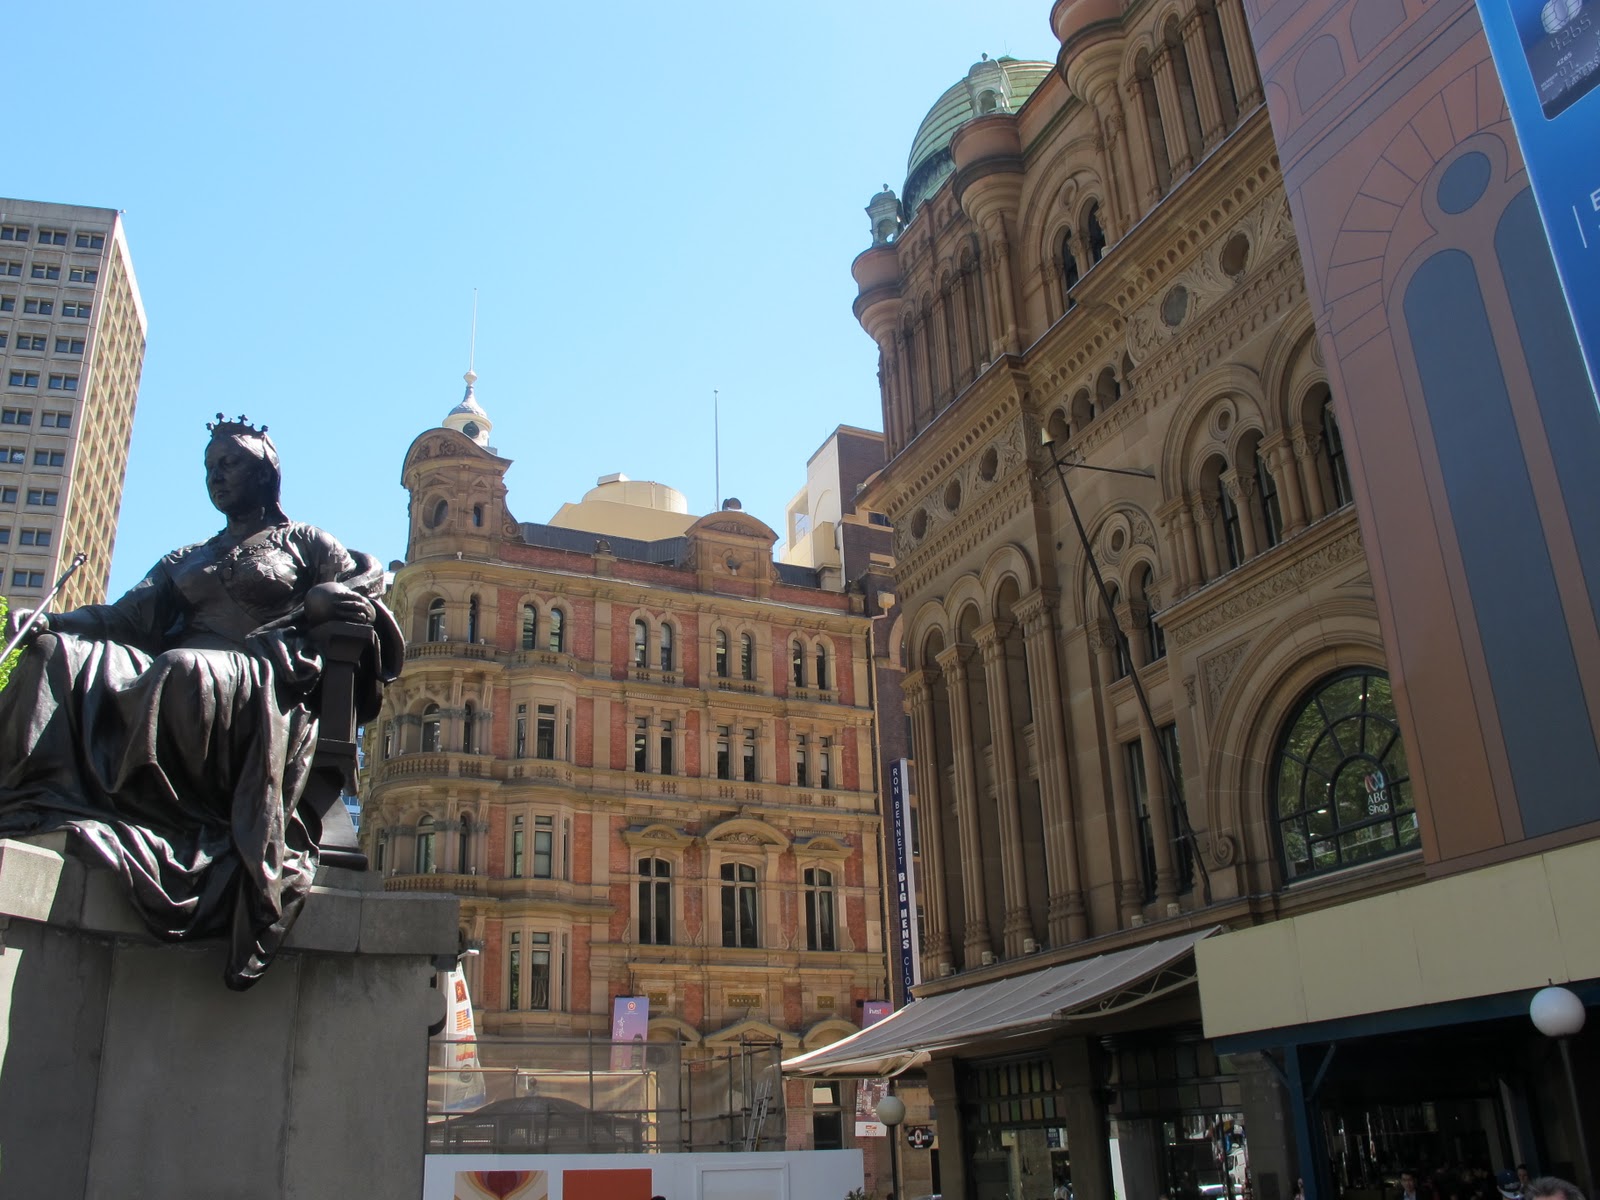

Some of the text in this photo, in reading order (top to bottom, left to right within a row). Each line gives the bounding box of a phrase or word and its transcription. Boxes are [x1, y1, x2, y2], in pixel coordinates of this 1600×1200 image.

[1367, 790, 1388, 805] ABC
[1368, 803, 1389, 815] Shop
[895, 801, 903, 865] BENNETT
[898, 872, 907, 902] BIG
[900, 909, 909, 949] MENS
